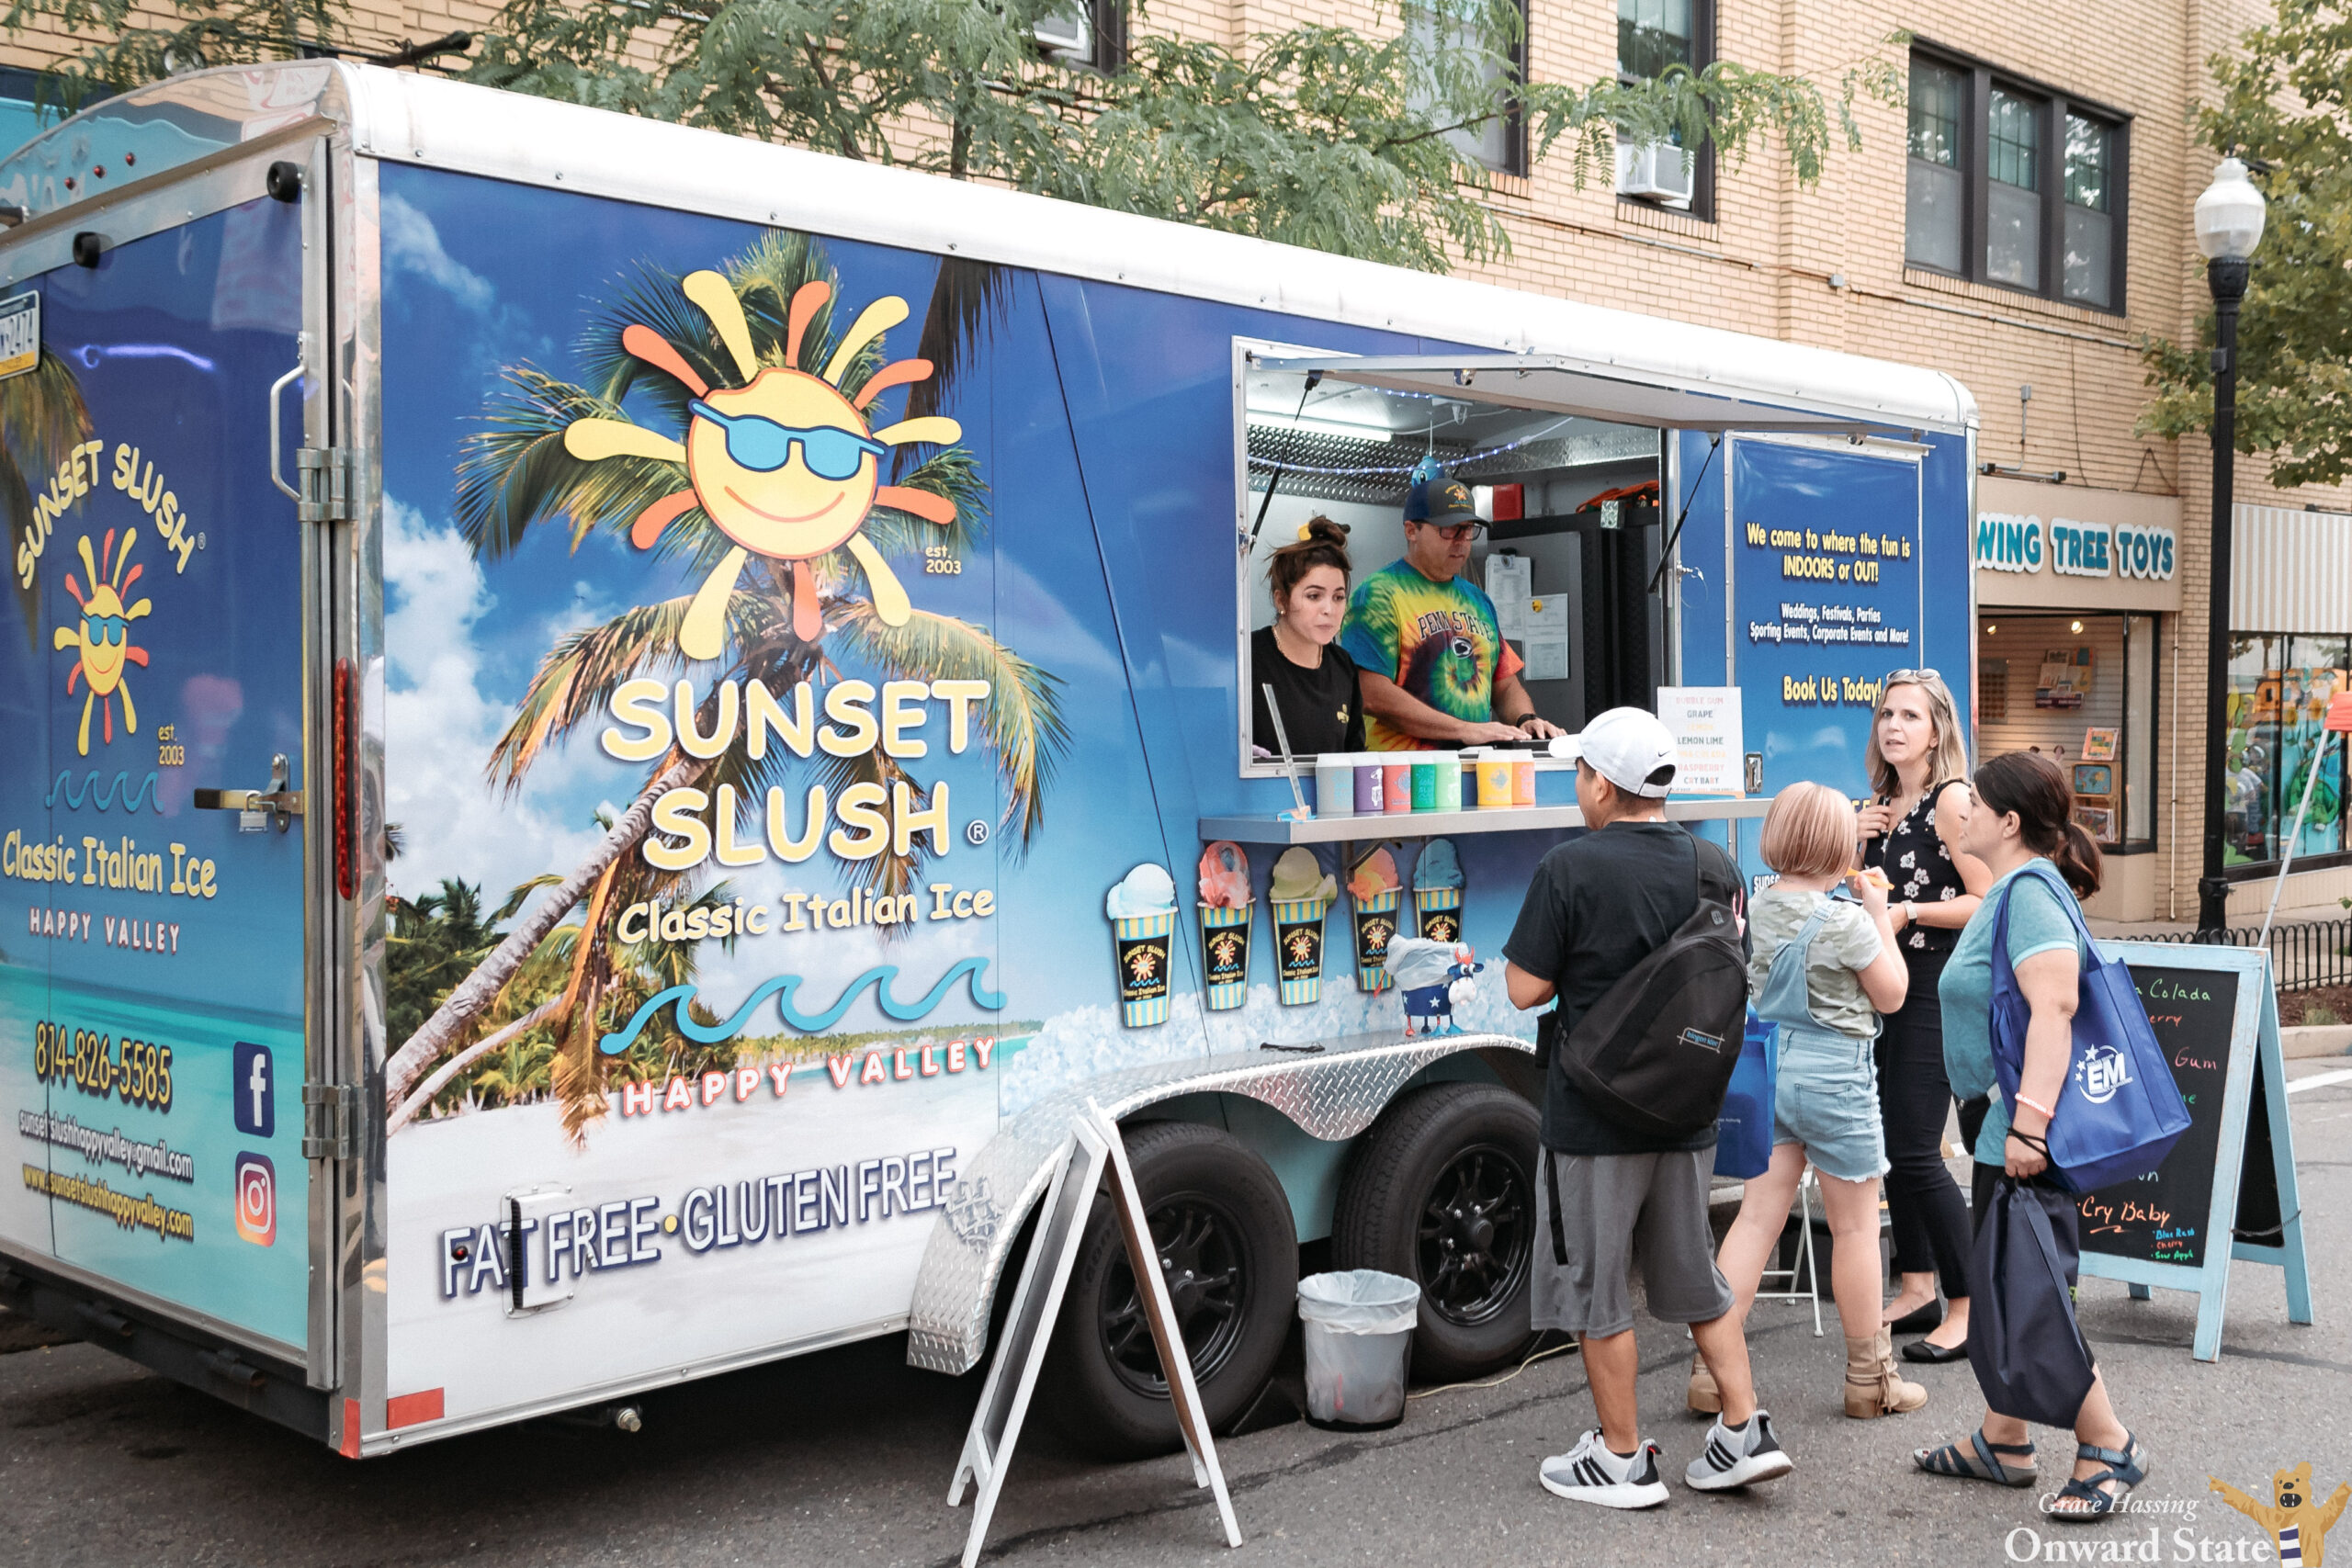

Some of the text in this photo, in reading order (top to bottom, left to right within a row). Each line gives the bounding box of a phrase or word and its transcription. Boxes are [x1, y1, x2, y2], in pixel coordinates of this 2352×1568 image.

[17, 439, 196, 590] SUNSET SLUSH
[925, 546, 952, 559] est.
[1747, 522, 1911, 558] We come to where the fun is
[2052, 524, 2110, 572] TREE
[2117, 528, 2175, 575] TOYS
[926, 558, 962, 575] 2003
[1783, 554, 1879, 583] INDOORS or OUT!
[1417, 610, 1494, 643] PENN STATE
[1781, 603, 1882, 625] Weddings, Festivals, Parties
[1749, 621, 1909, 644] Sporting Events, Corporate Events and More!
[1783, 674, 1883, 708] Book Us Today!
[602, 678, 990, 761] SUNSET
[1687, 710, 1713, 718] GRAPE
[158, 725, 178, 742] est.
[1678, 736, 1724, 745] LEMON LIME
[159, 746, 185, 766] 2003
[1678, 763, 1724, 772] RASPBERRY
[642, 781, 950, 871] SLUSH
[3, 829, 218, 899] Classic Italian Ice
[616, 884, 995, 944] Classic Italian Ice
[29, 908, 180, 955] HAPPY VALLEY
[2150, 978, 2211, 1000] Colada
[35, 1021, 173, 1113] 814-826-5585
[2086, 1052, 2126, 1094] EM
[2175, 1046, 2217, 1070] Gum
[622, 1036, 995, 1117] HAPPY VALLEY
[22, 1163, 194, 1242] www.sunsetslushhappyvalley.com
[683, 1165, 847, 1253] GLUTEN
[859, 1146, 956, 1221] FREE
[2082, 1195, 2170, 1228] Cry Baby
